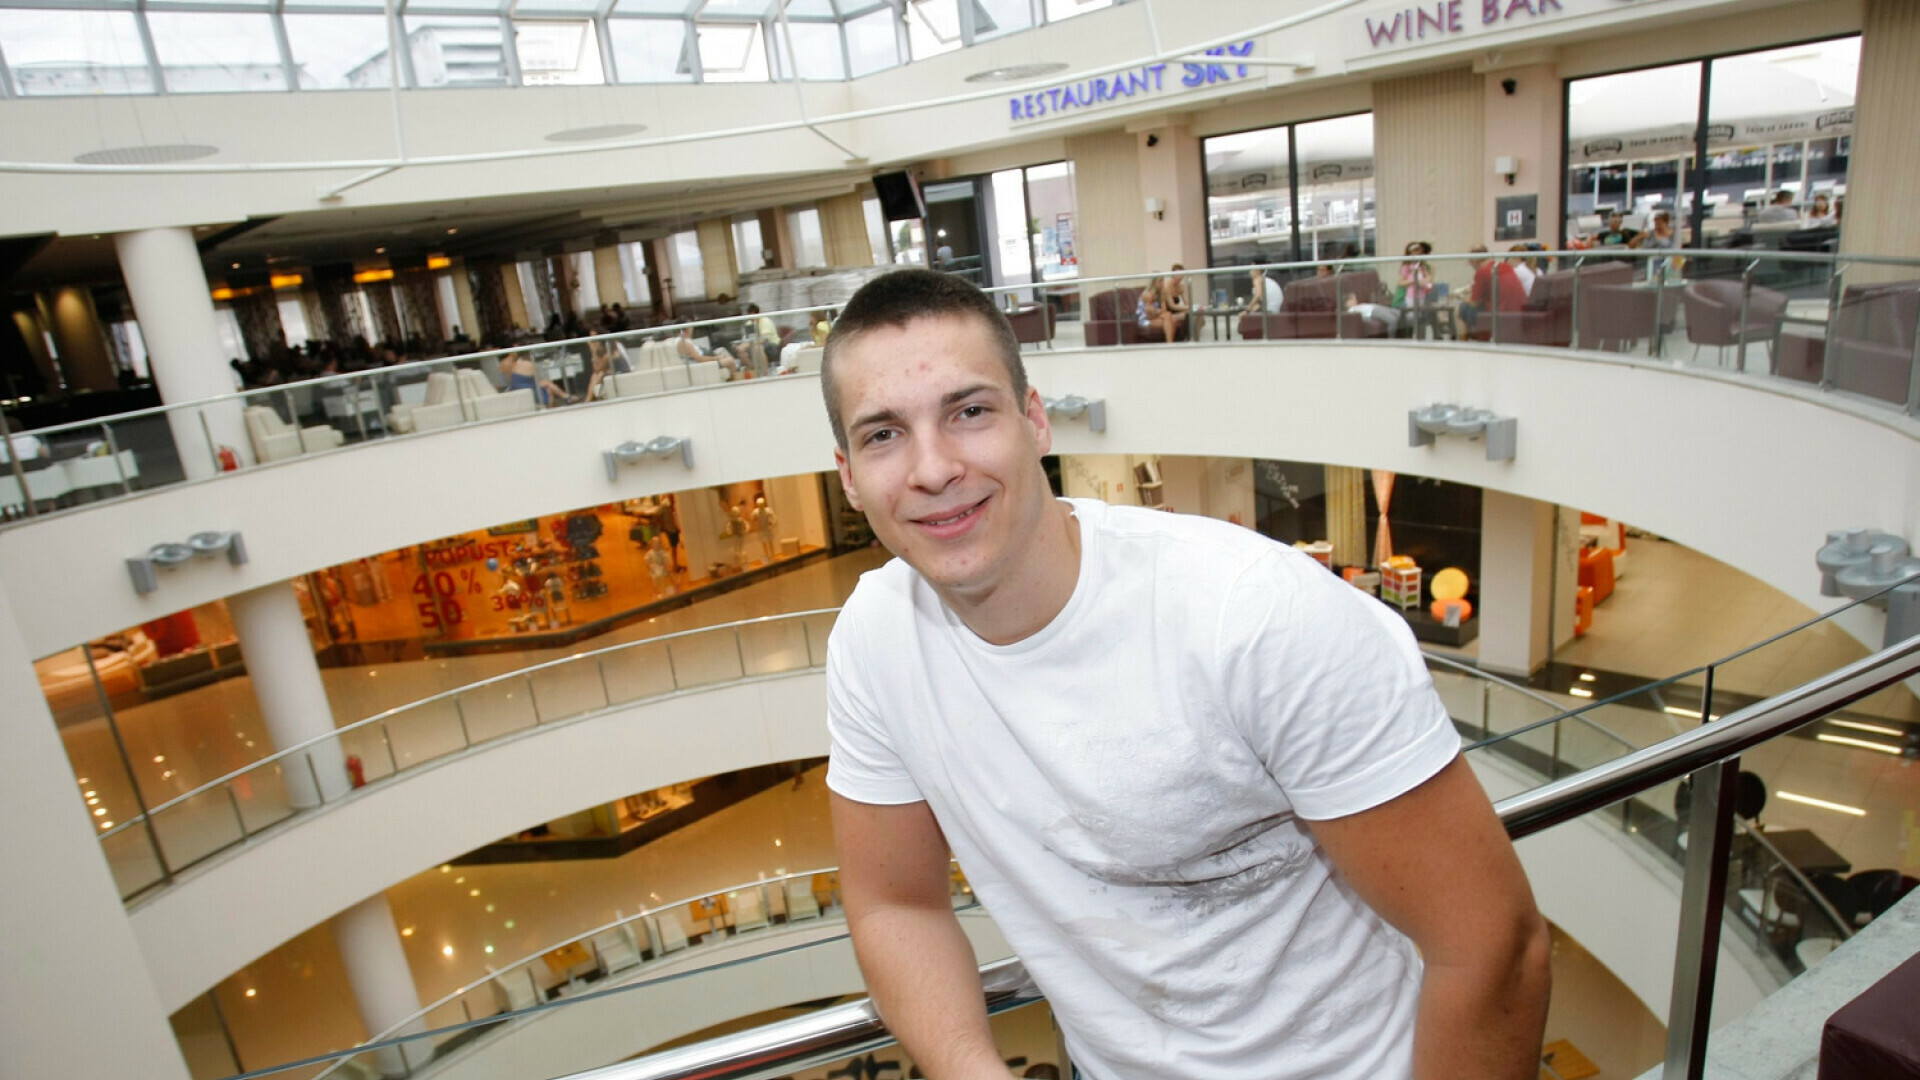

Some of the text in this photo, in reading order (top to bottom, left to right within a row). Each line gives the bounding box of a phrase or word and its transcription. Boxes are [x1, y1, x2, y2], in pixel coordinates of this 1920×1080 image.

[1365, 0, 1463, 47] WINE
[1010, 40, 1254, 120] RESTAURANT SKY
